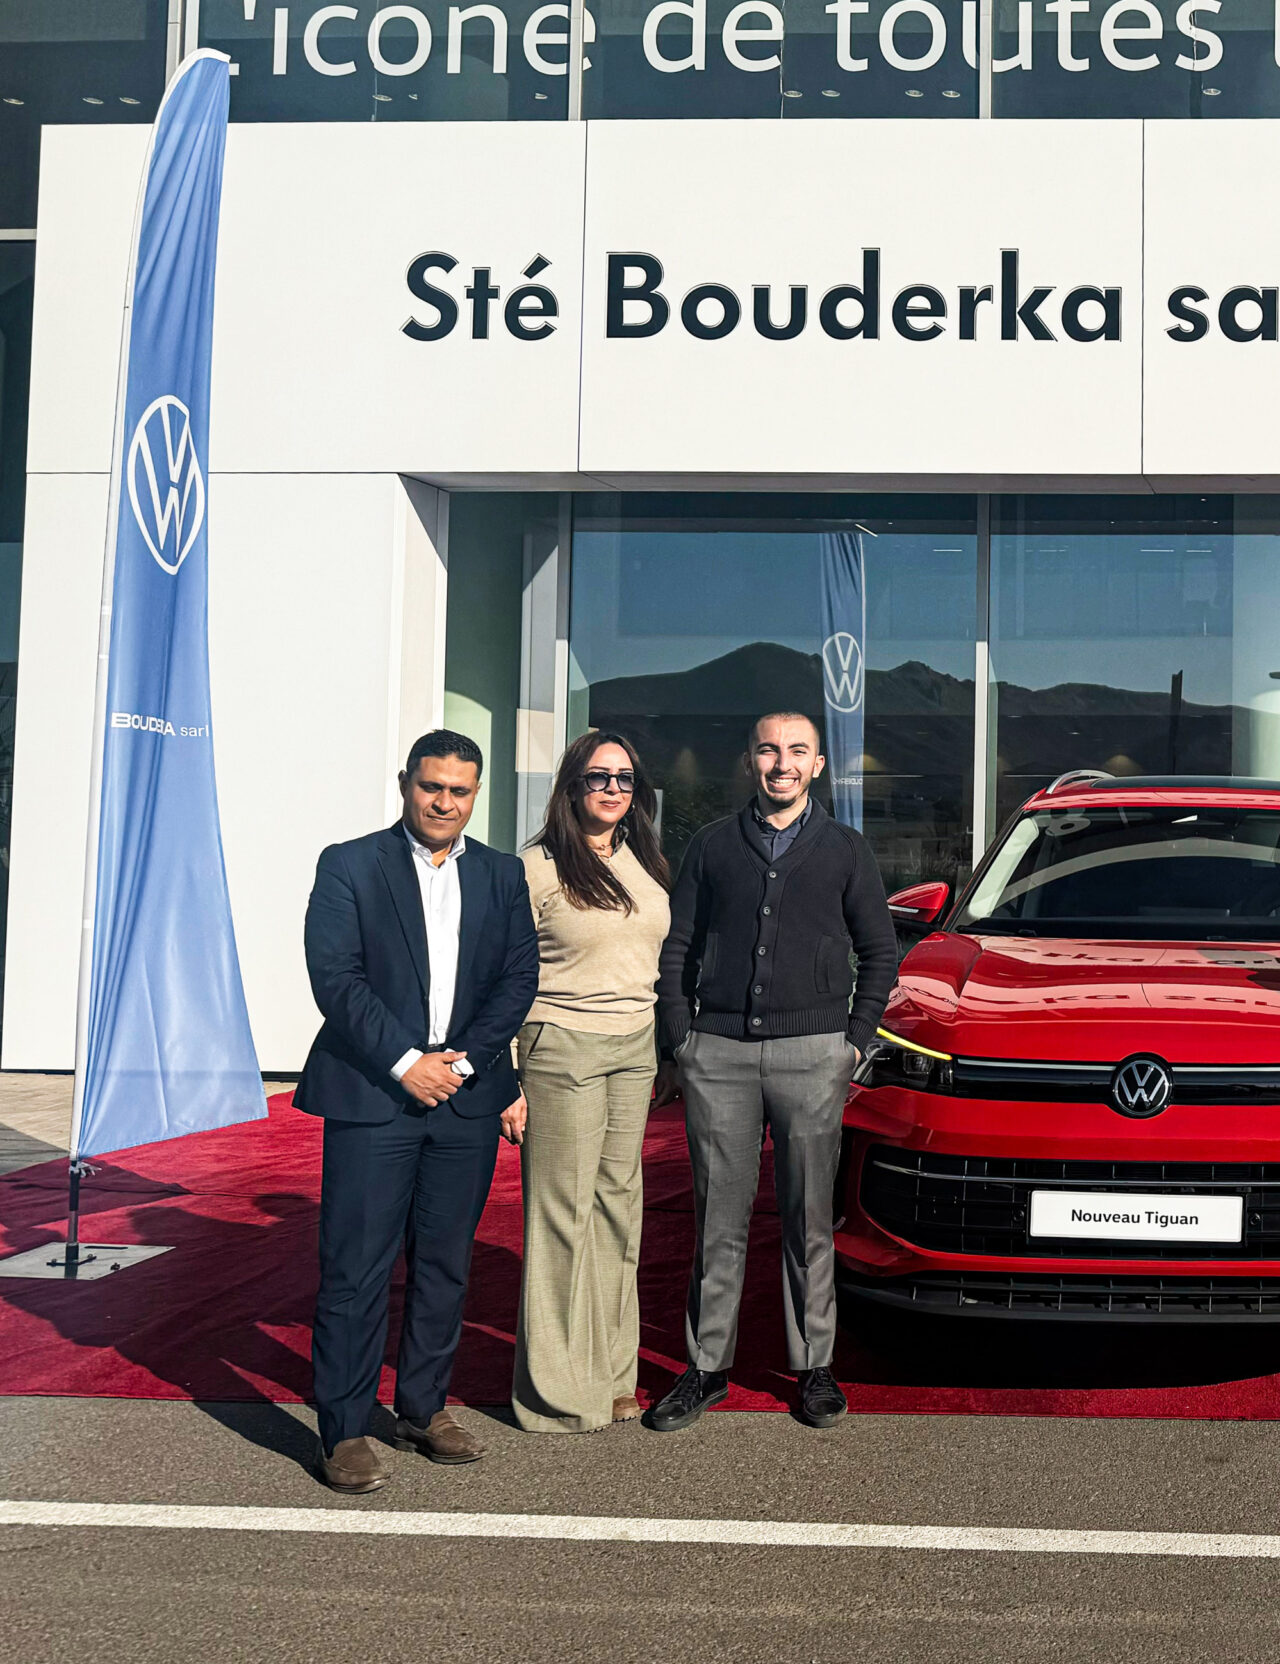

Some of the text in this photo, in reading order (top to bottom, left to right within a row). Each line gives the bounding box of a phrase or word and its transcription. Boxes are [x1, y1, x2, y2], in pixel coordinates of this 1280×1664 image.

[641, 0, 784, 74] de
[826, 0, 1224, 73] toutes
[401, 250, 560, 342] Sté
[605, 247, 1123, 343] Bouderka
[180, 724, 210, 737] sarl
[1071, 1208, 1199, 1228] Nouveau Tiguan
